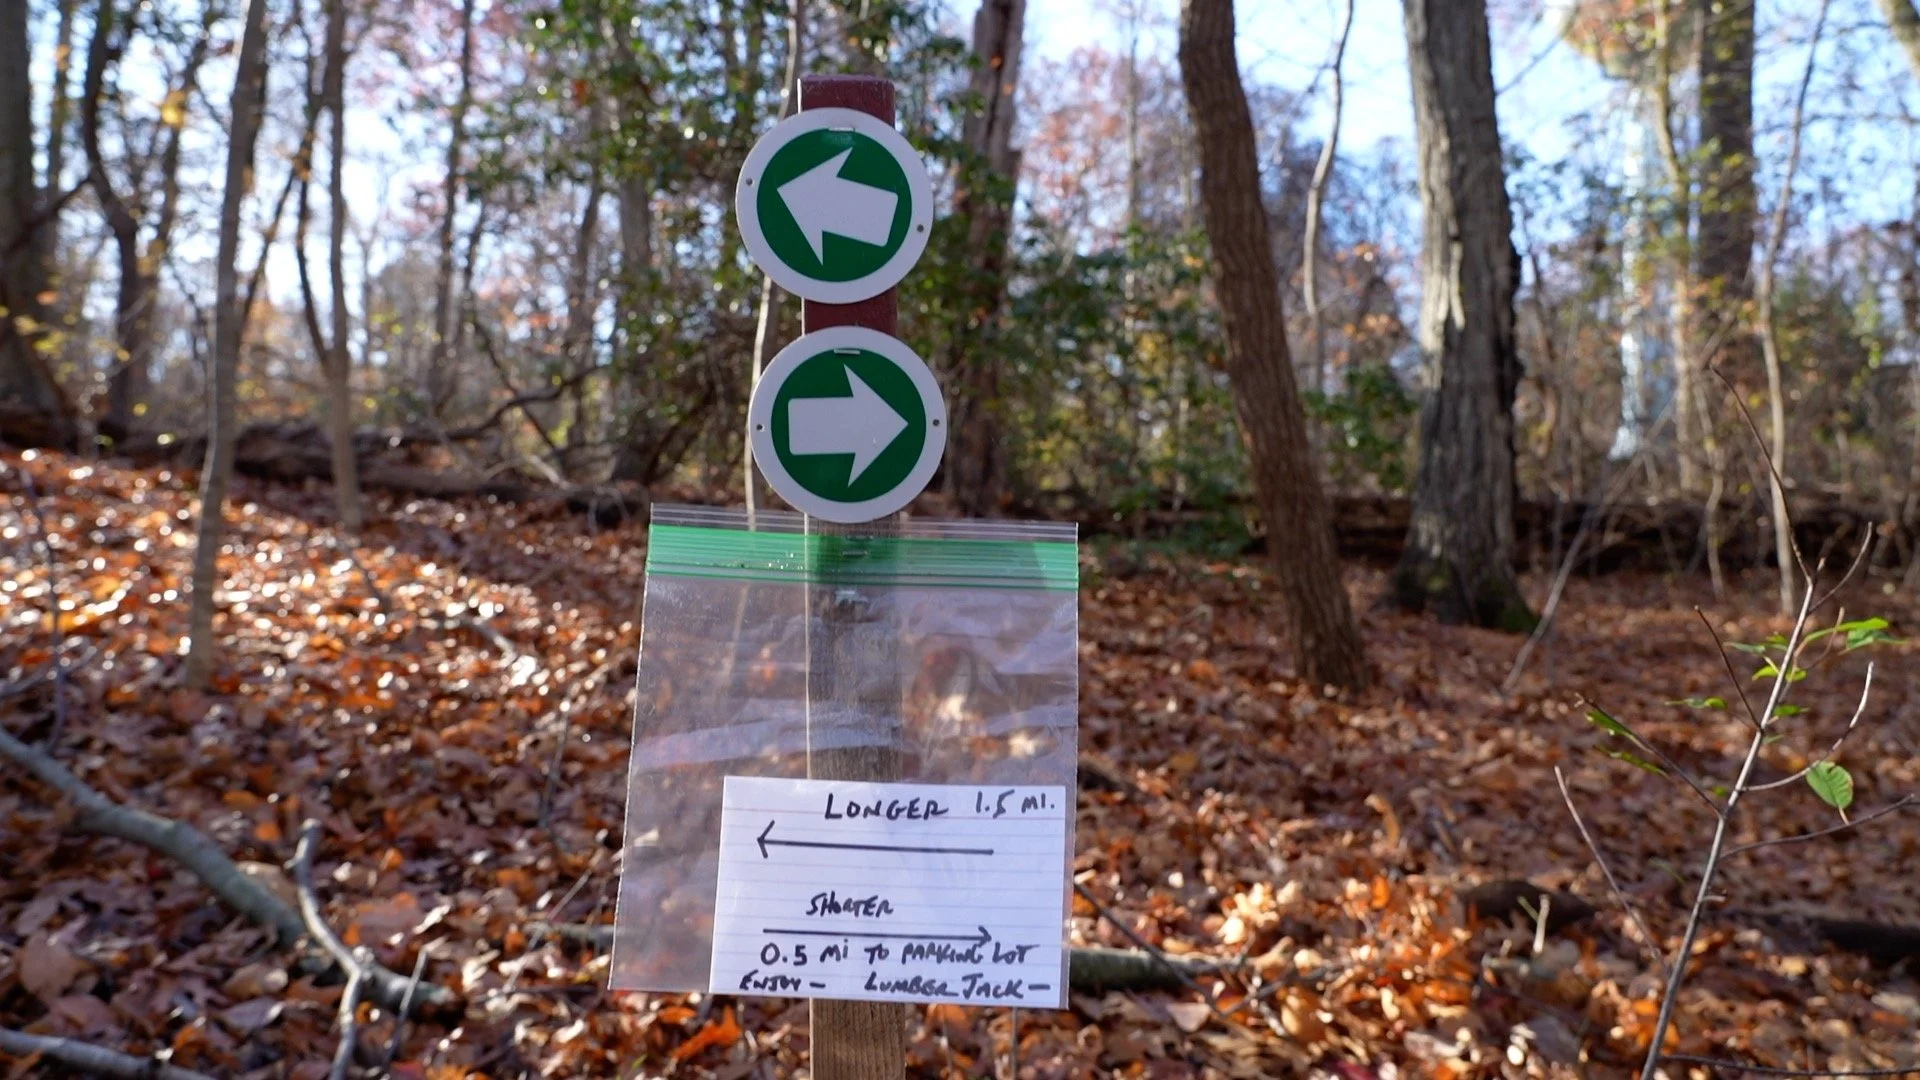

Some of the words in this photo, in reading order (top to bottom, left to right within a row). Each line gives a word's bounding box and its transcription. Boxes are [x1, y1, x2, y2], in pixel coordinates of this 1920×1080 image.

[824, 793, 948, 820] LONGER
[976, 789, 1015, 819] 1.5
[806, 891, 894, 918] SHORTER
[760, 943, 808, 966] 0.5
[864, 945, 890, 964] TO
[901, 943, 983, 964] PARKING
[992, 943, 1040, 963] LOT
